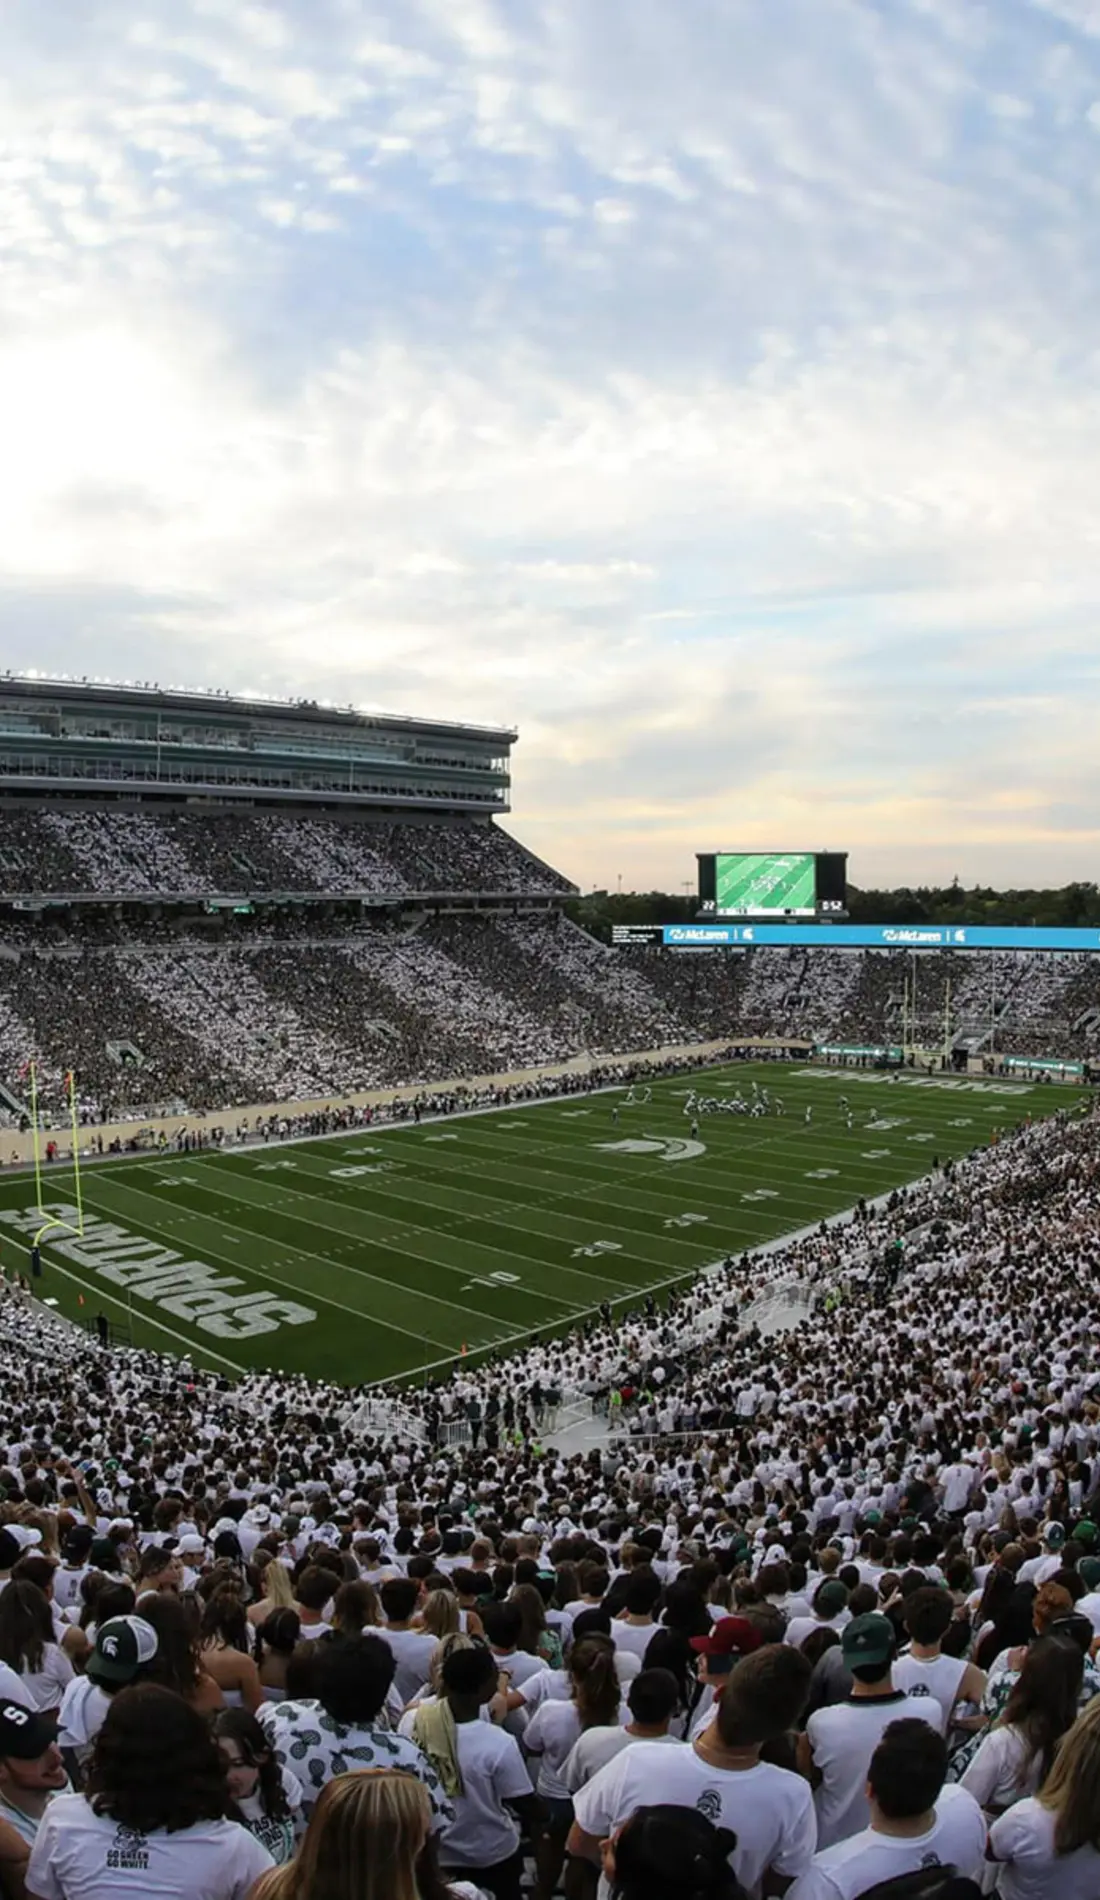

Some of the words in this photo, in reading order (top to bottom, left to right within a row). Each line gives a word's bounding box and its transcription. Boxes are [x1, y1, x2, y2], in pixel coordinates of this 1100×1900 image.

[686, 929, 729, 940] McLaren
[898, 930, 941, 941] McLaren
[0, 1203, 317, 1339] SPARTANS
[470, 1270, 521, 1288] 10
[3, 1706, 28, 1725] S
[106, 1849, 119, 1858] GO
[106, 1859, 119, 1868] GO
